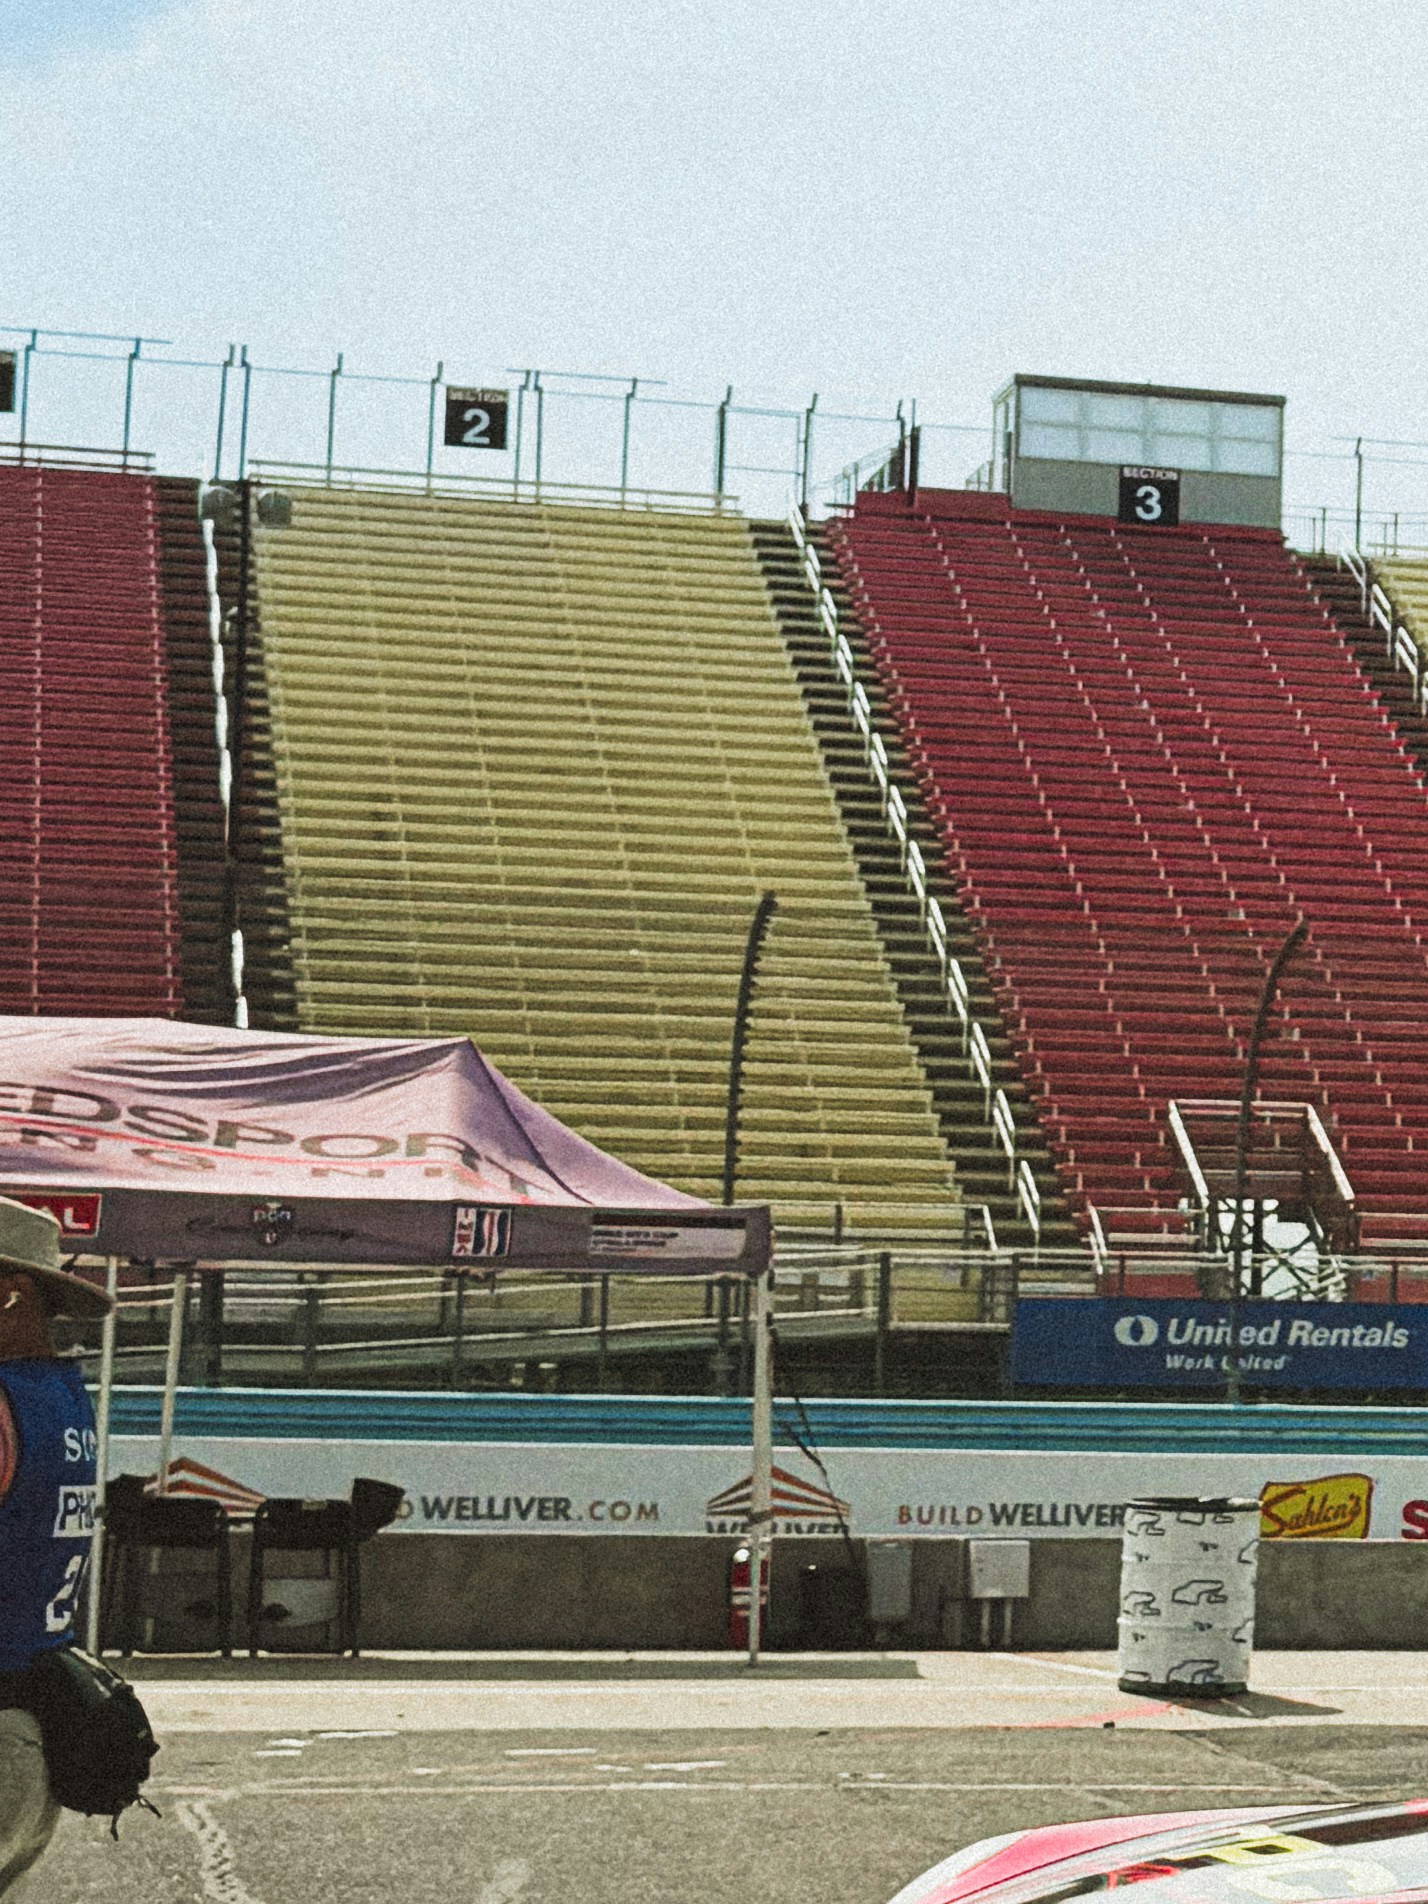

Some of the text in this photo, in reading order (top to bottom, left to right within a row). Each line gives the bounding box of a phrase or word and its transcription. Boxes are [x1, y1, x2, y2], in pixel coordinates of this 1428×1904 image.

[462, 408, 491, 444] 2
[1135, 485, 1162, 521] 3
[1167, 1318, 1410, 1348] Unied Rentals
